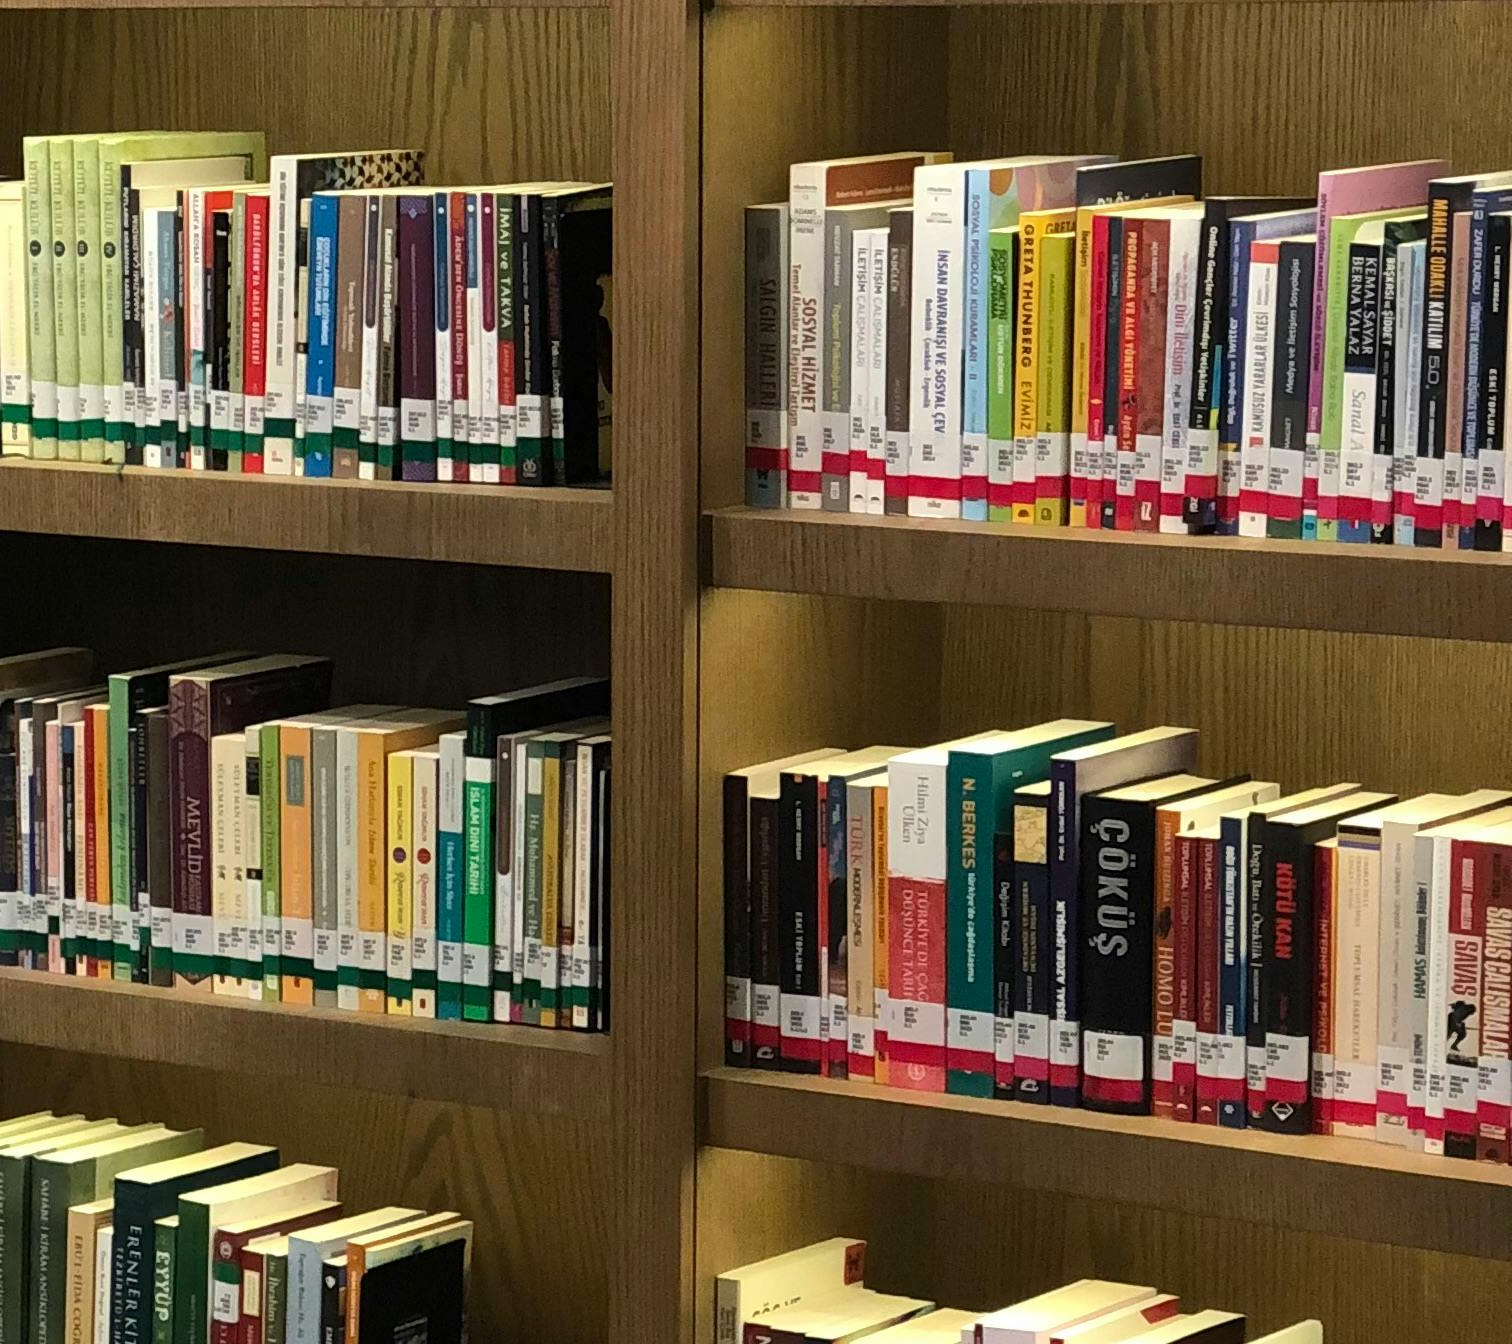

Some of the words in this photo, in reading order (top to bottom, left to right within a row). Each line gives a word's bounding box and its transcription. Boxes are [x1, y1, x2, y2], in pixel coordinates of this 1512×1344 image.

[1023, 224, 1034, 275] GRETA
[1431, 198, 1448, 254] MAHALLE
[499, 252, 508, 270] ve
[936, 249, 949, 285] İNSAN
[1126, 231, 1137, 298] PROPAGANDA
[1350, 256, 1364, 305] BERNA
[1363, 257, 1377, 308] KEMAL
[1429, 256, 1446, 299] ODAKLI
[500, 277, 511, 329] TAKVA
[801, 297, 817, 352] SOSYAL
[933, 288, 947, 349] DAVRANIŞI
[1021, 280, 1033, 368] THUNBERG
[1124, 316, 1135, 341] ALGI
[1125, 301, 1135, 315] VE
[1428, 301, 1445, 350] KATILIM
[1348, 308, 1362, 355] YALAZ
[1361, 310, 1376, 355] SAYAR
[801, 356, 818, 413] HİZMET
[935, 352, 947, 367] VE
[934, 369, 946, 410] SOSYAL
[961, 777, 976, 796] N.
[185, 796, 204, 875] MEVLİD
[961, 800, 976, 870] BERKES
[1091, 817, 1137, 957] ÇÖKÜŞ
[1275, 861, 1296, 914] KÖTÜ
[1274, 916, 1293, 960] KAN
[1157, 945, 1174, 1006] HOMO
[1413, 958, 1426, 999] HAMAS
[126, 1224, 142, 1312] ERENLER
